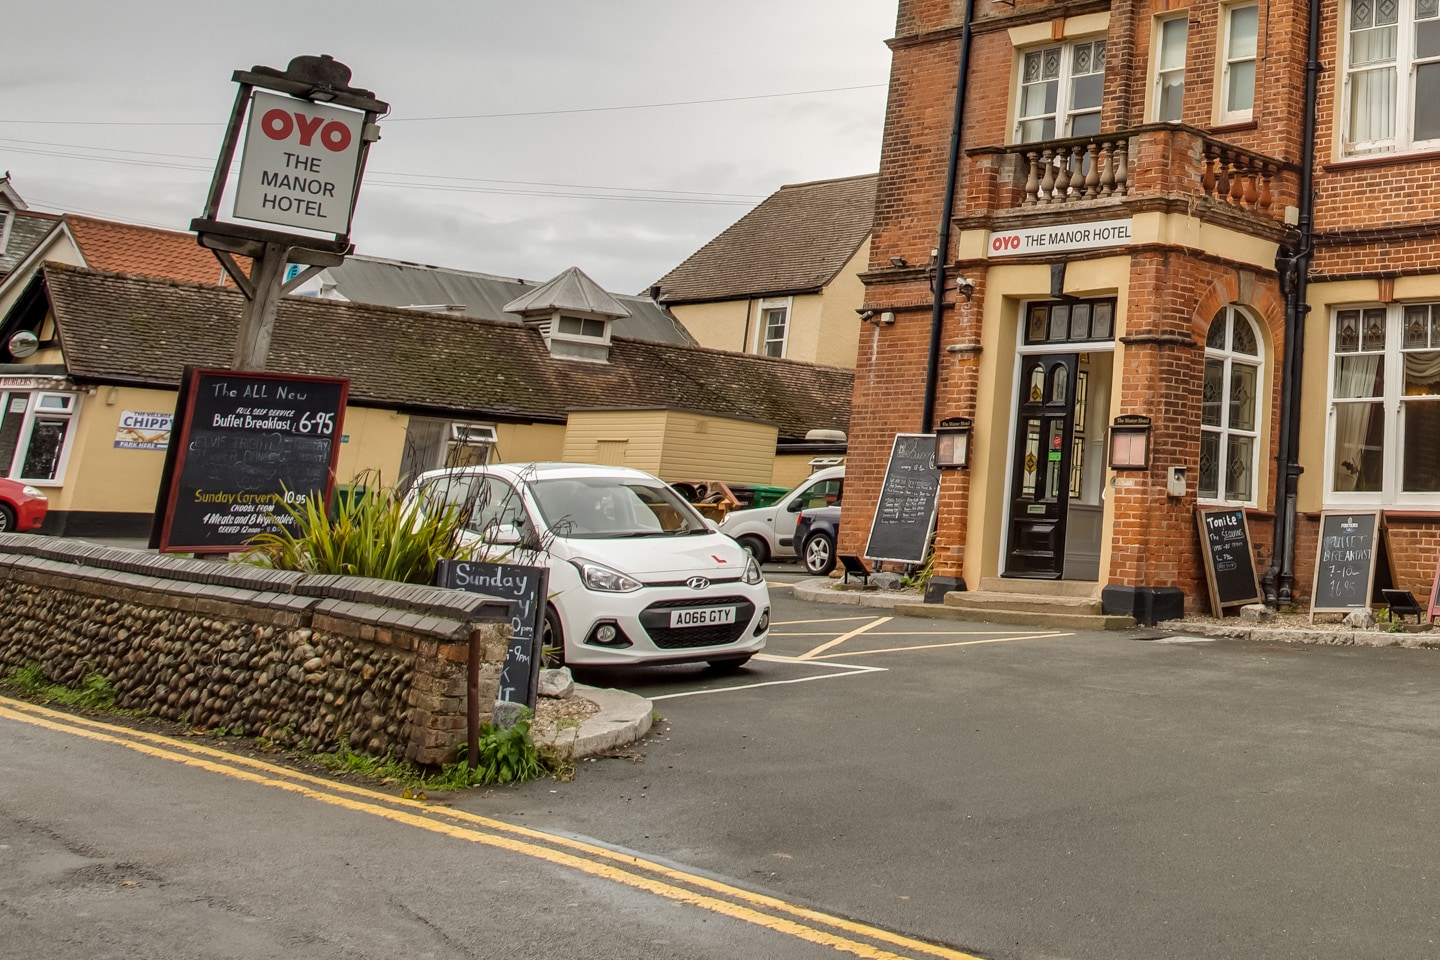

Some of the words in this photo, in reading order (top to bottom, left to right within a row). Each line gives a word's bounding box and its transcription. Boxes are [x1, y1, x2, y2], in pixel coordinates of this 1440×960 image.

[261, 108, 351, 152] OYO
[283, 152, 322, 173] THE
[260, 171, 335, 198] MANOR
[262, 193, 327, 219] HOTEL
[992, 235, 1021, 251] OYO
[1025, 233, 1046, 247] THE
[1049, 229, 1090, 245] MANOR
[1093, 225, 1131, 241] HOTEL
[212, 383, 238, 397] The
[243, 384, 268, 398] ALL
[276, 386, 308, 400] New
[235, 406, 252, 415] FULL
[252, 408, 269, 416] SELF
[268, 409, 295, 417] SERVICE
[212, 413, 243, 428] Buffet
[244, 415, 290, 430] Breakfast
[194, 489, 235, 504] Sunday
[255, 504, 275, 512] FROM
[203, 513, 210, 524] 4
[208, 513, 234, 524] Meats
[234, 513, 250, 524] and
[249, 513, 257, 525] 8
[1206, 515, 1237, 529] Tonite
[456, 563, 528, 595] Sunday
[676, 610, 707, 625] AO66
[709, 609, 731, 622] GTY
